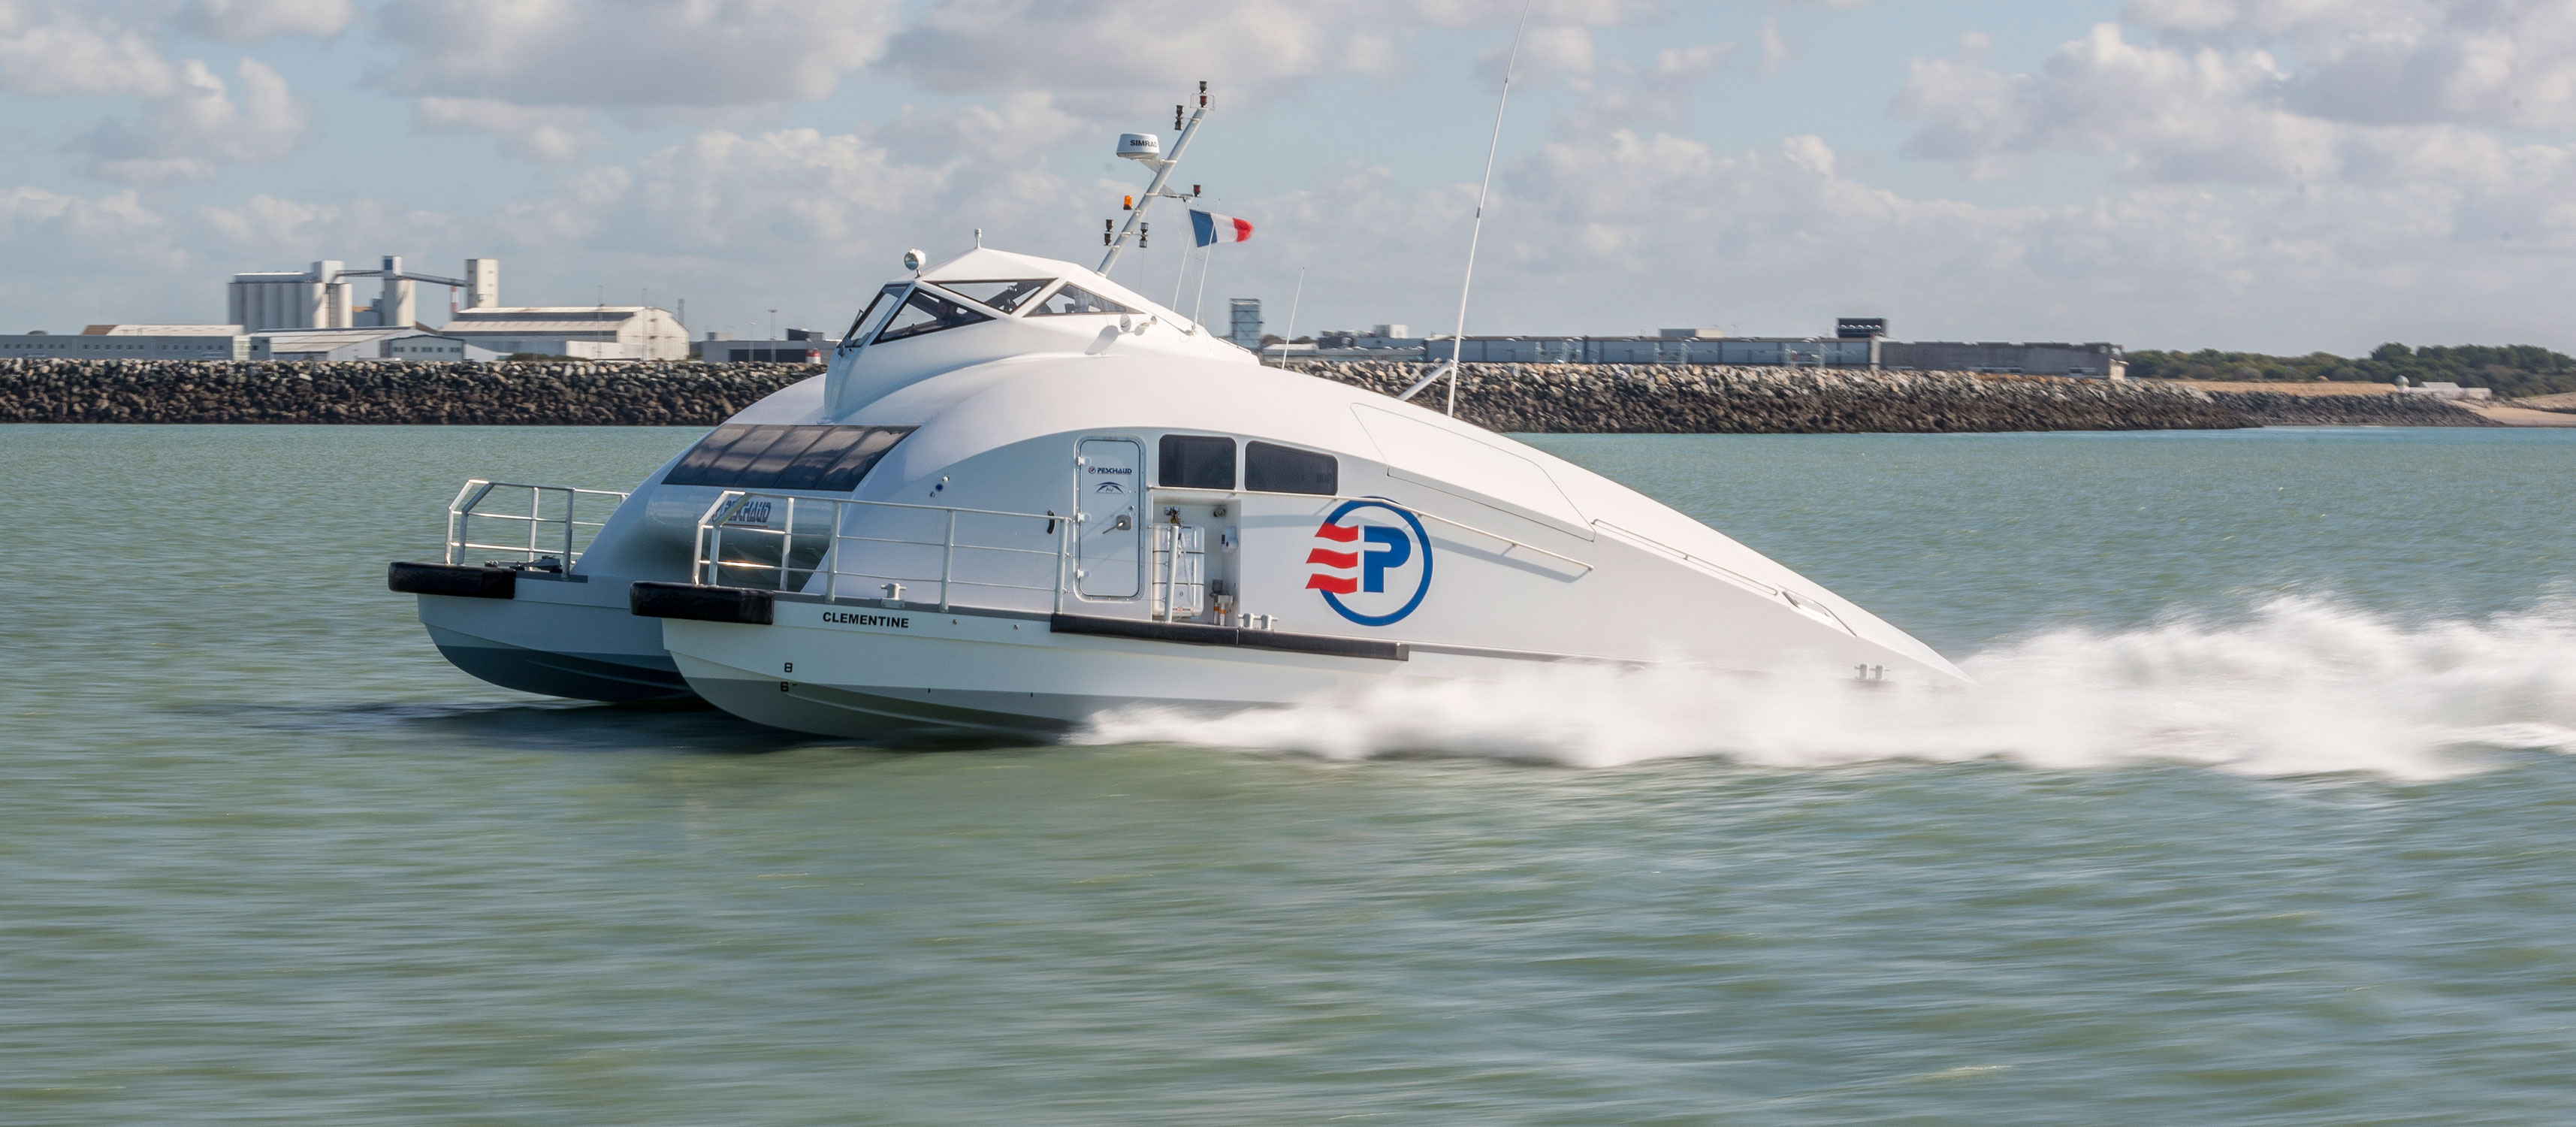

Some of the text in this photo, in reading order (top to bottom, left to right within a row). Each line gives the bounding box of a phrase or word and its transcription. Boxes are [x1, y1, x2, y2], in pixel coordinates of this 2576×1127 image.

[1130, 139, 1158, 147] SIMRAD
[822, 612, 909, 628] CLEMENTINE
[784, 663, 793, 672] 8
[781, 681, 789, 692] 6
